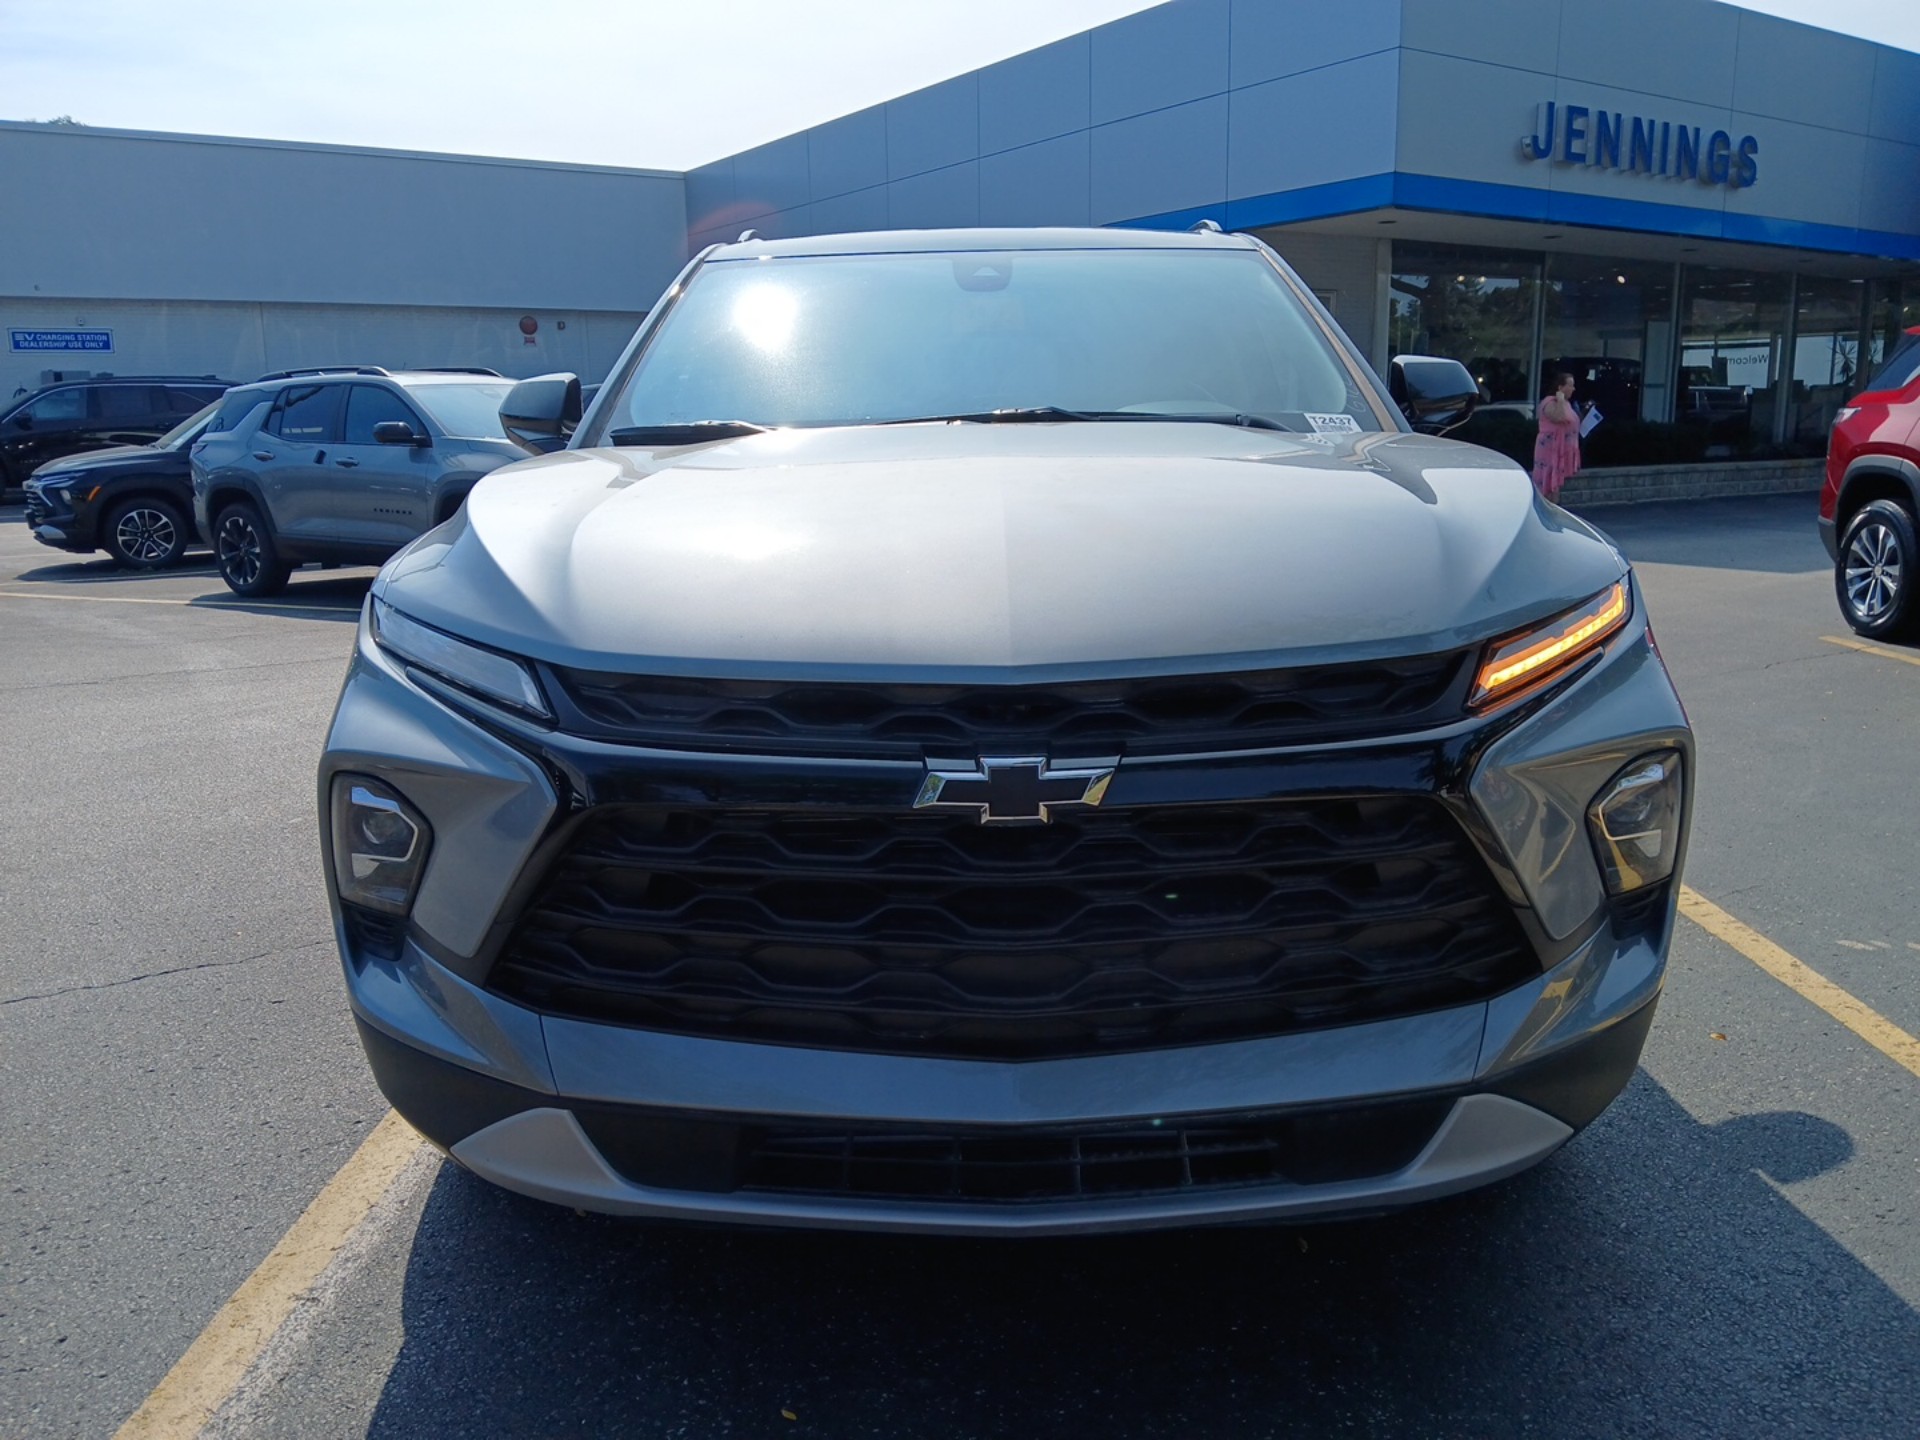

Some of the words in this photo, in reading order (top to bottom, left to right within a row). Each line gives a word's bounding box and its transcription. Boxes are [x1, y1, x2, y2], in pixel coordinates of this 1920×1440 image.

[1529, 100, 1759, 188] JENNINGS
[15, 333, 34, 341] EV
[36, 333, 76, 341] CHARGING
[77, 333, 108, 341] STATION
[1308, 415, 1352, 426] T2437
